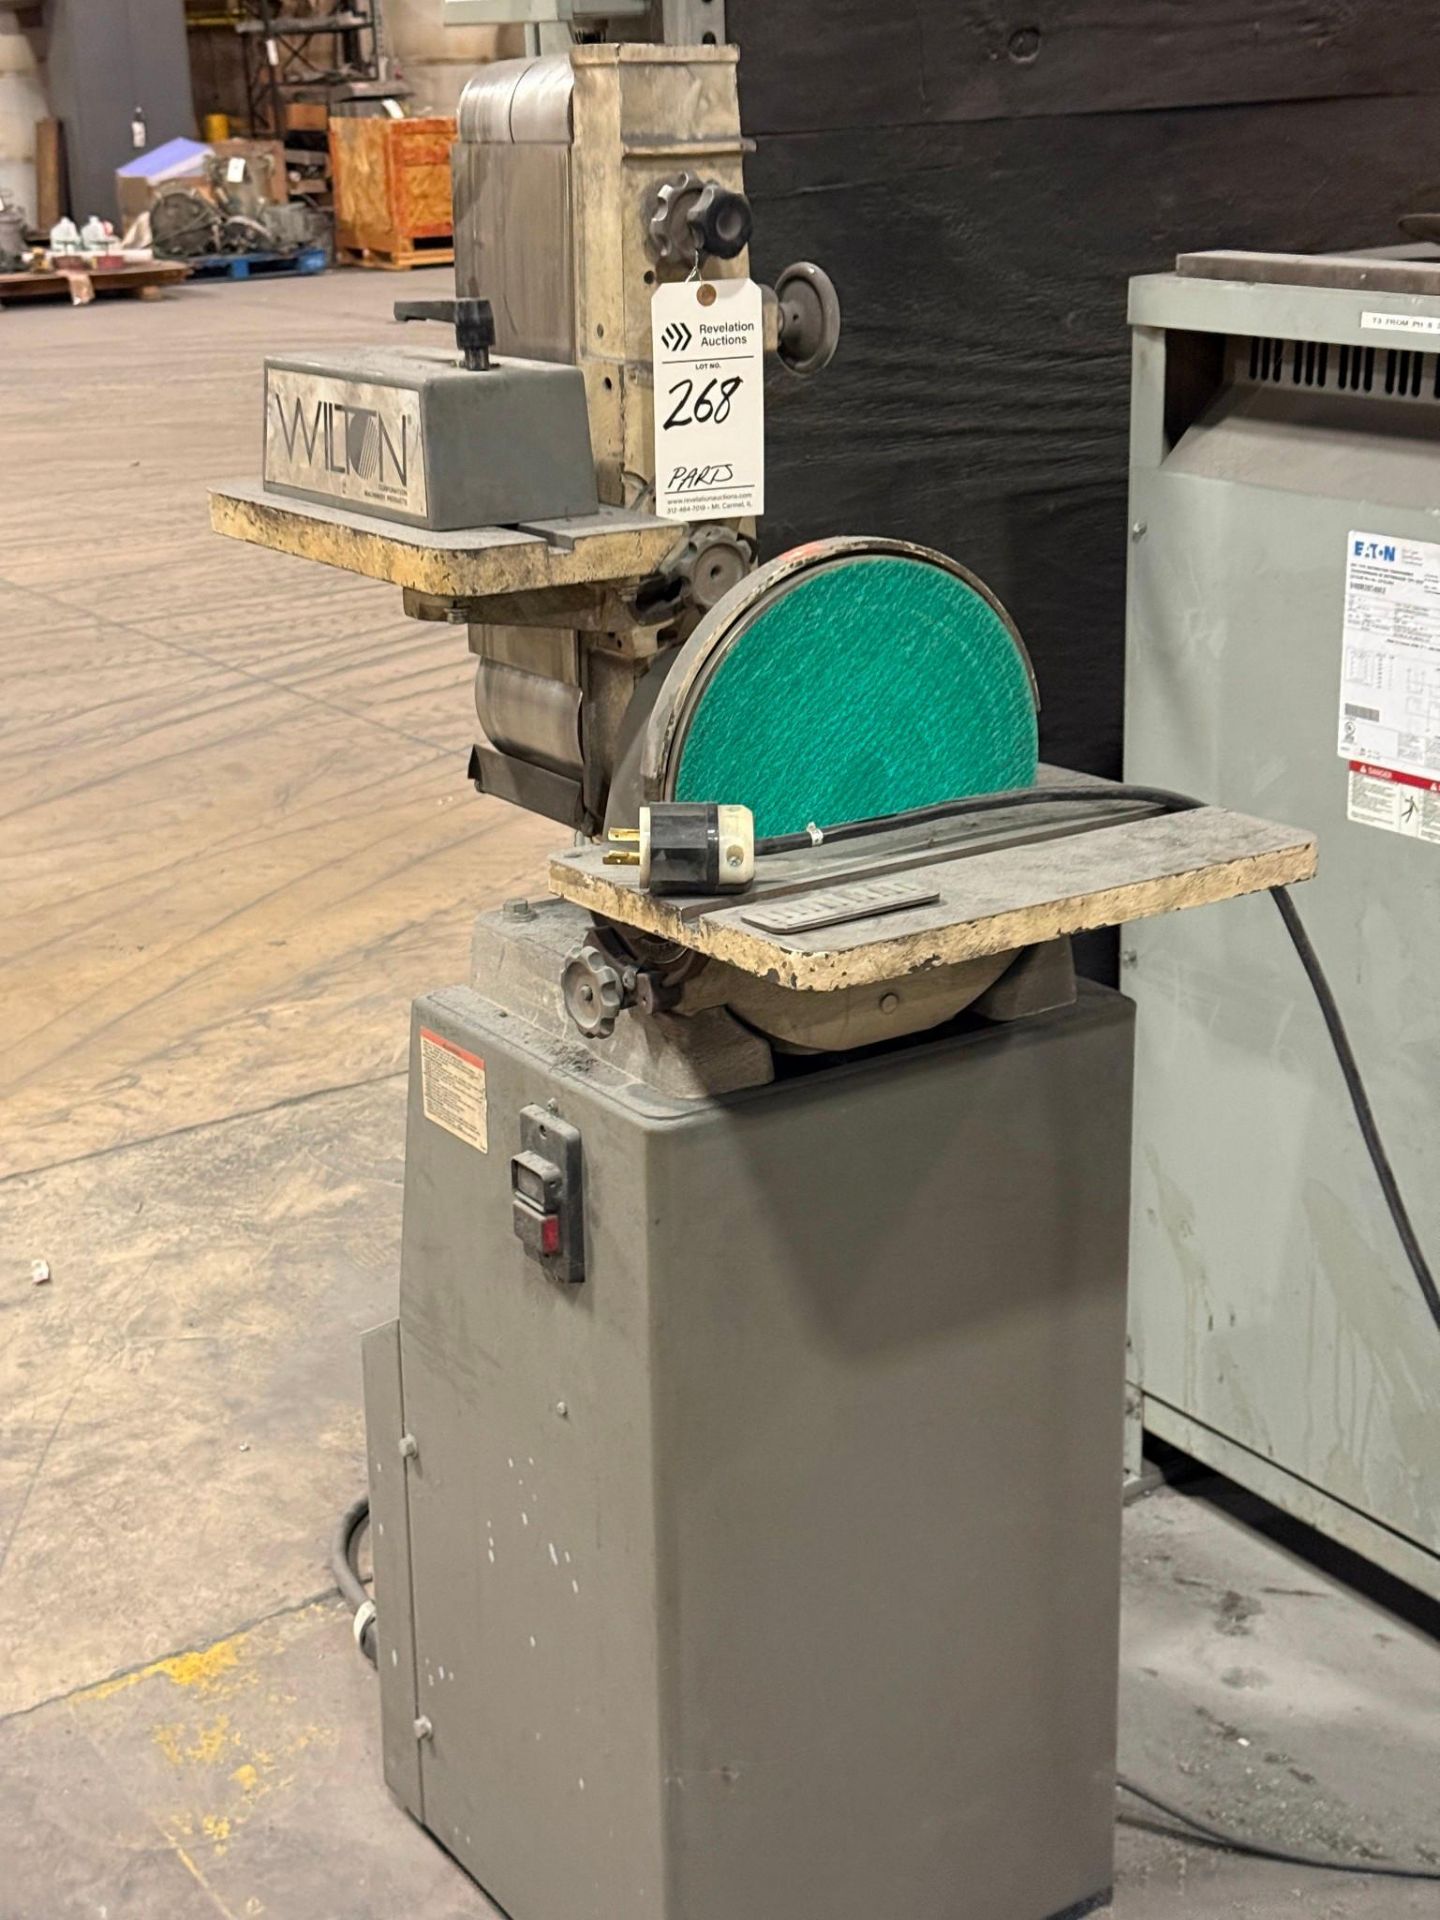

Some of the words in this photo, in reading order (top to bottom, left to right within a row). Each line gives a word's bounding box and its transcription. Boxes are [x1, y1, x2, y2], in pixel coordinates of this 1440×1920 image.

[699, 320, 755, 334] Revelation
[701, 334, 748, 347] Auctions
[663, 375, 744, 431] 268
[276, 393, 407, 487] WILTON
[668, 463, 734, 491] PARTS
[1354, 541, 1396, 562] EATON
